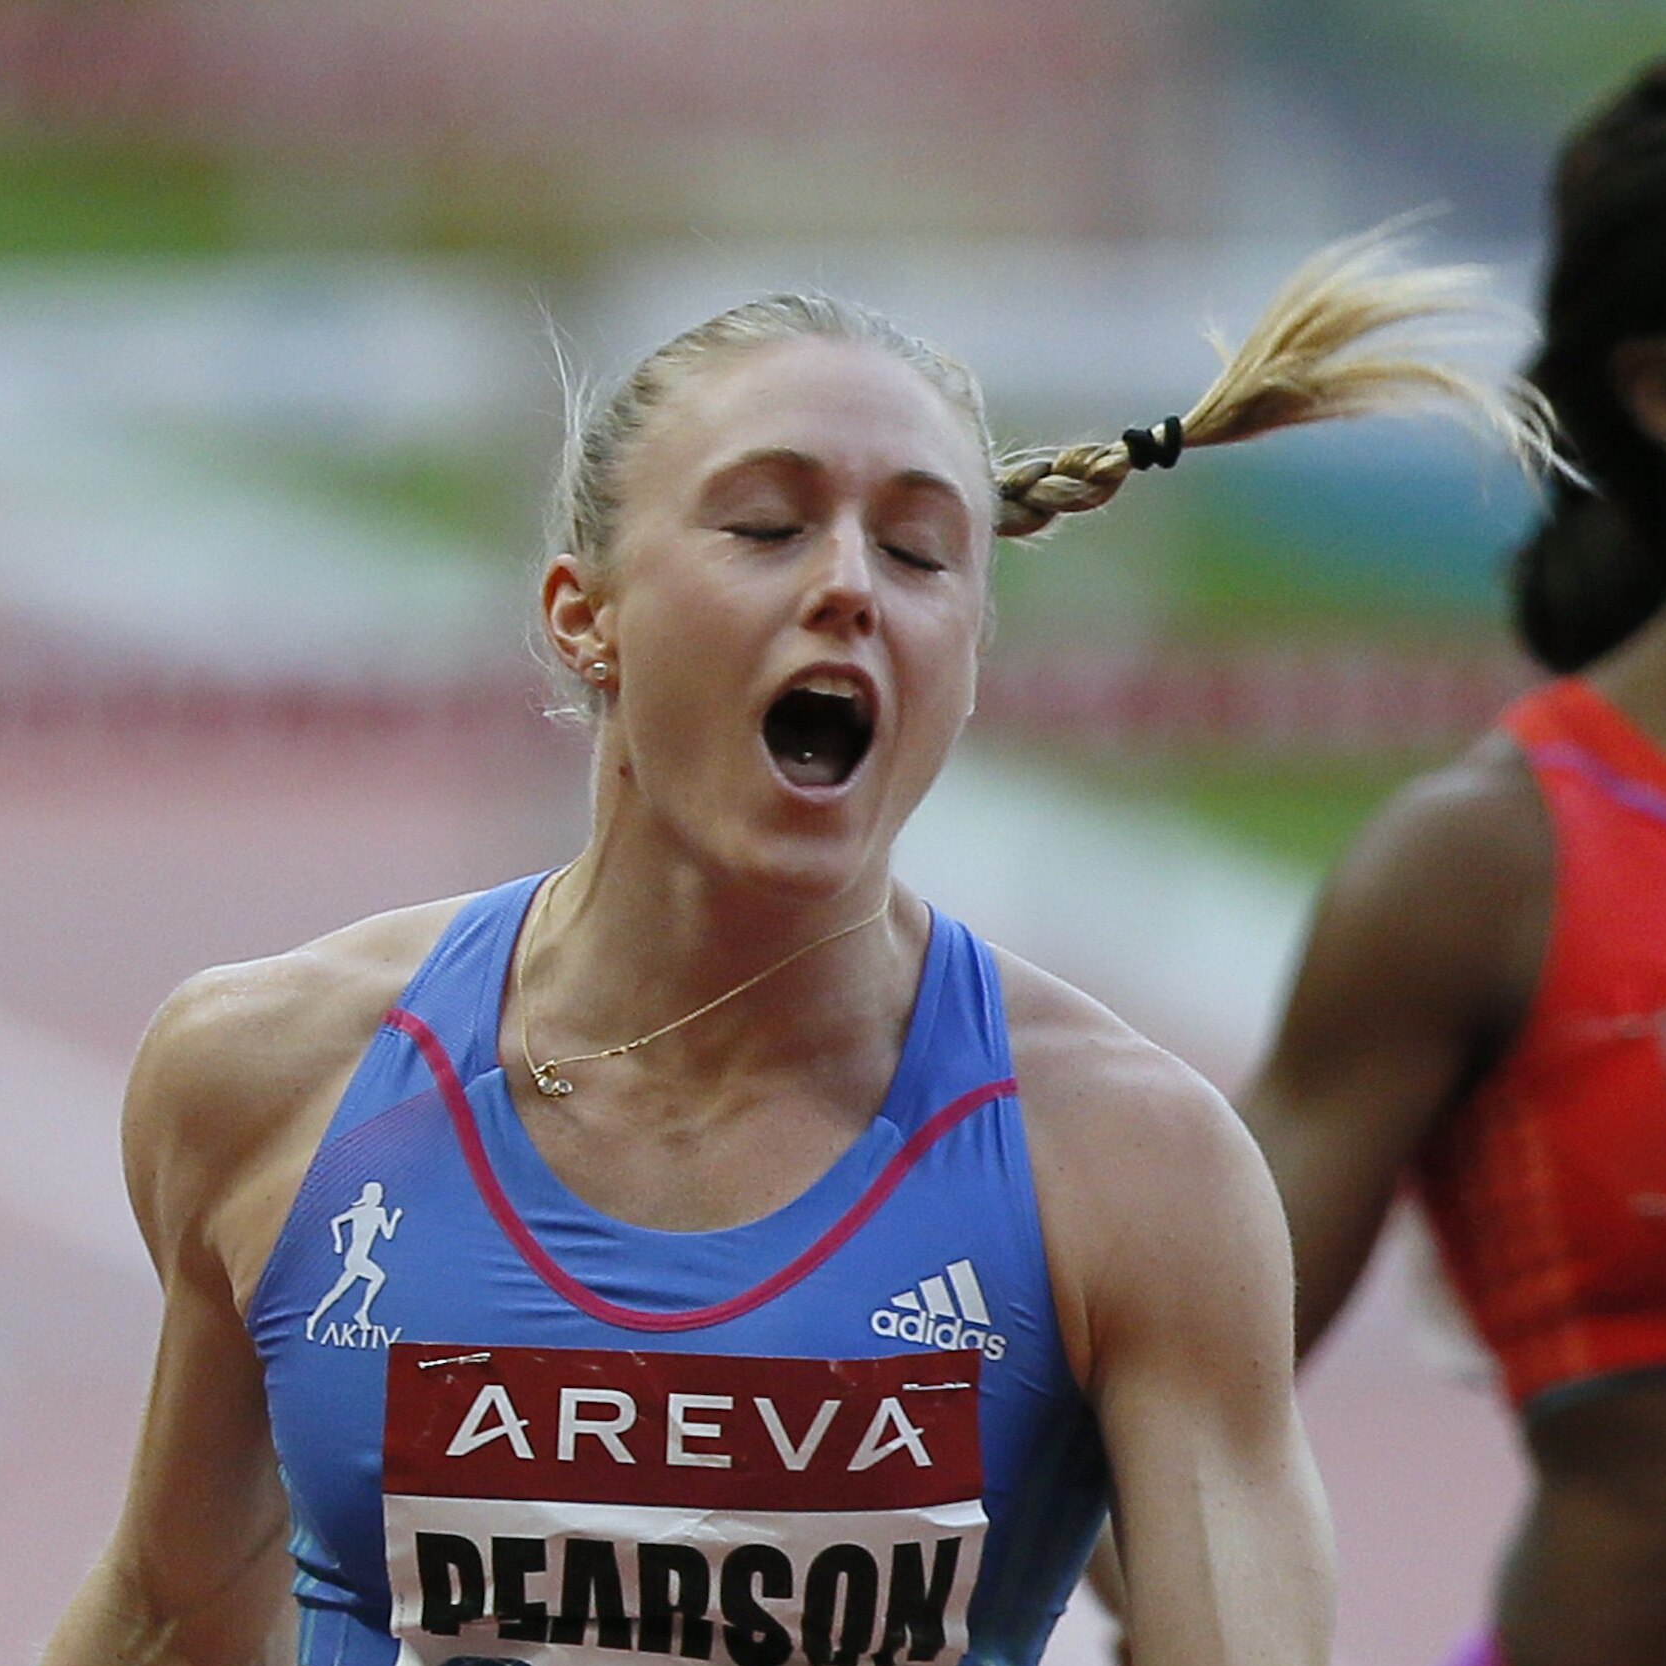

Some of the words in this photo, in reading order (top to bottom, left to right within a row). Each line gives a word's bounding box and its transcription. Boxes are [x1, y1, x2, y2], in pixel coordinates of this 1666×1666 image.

[320, 1323, 403, 1349] AKTIV
[870, 1310, 1007, 1361] adidas
[445, 1384, 933, 1472] AREVA
